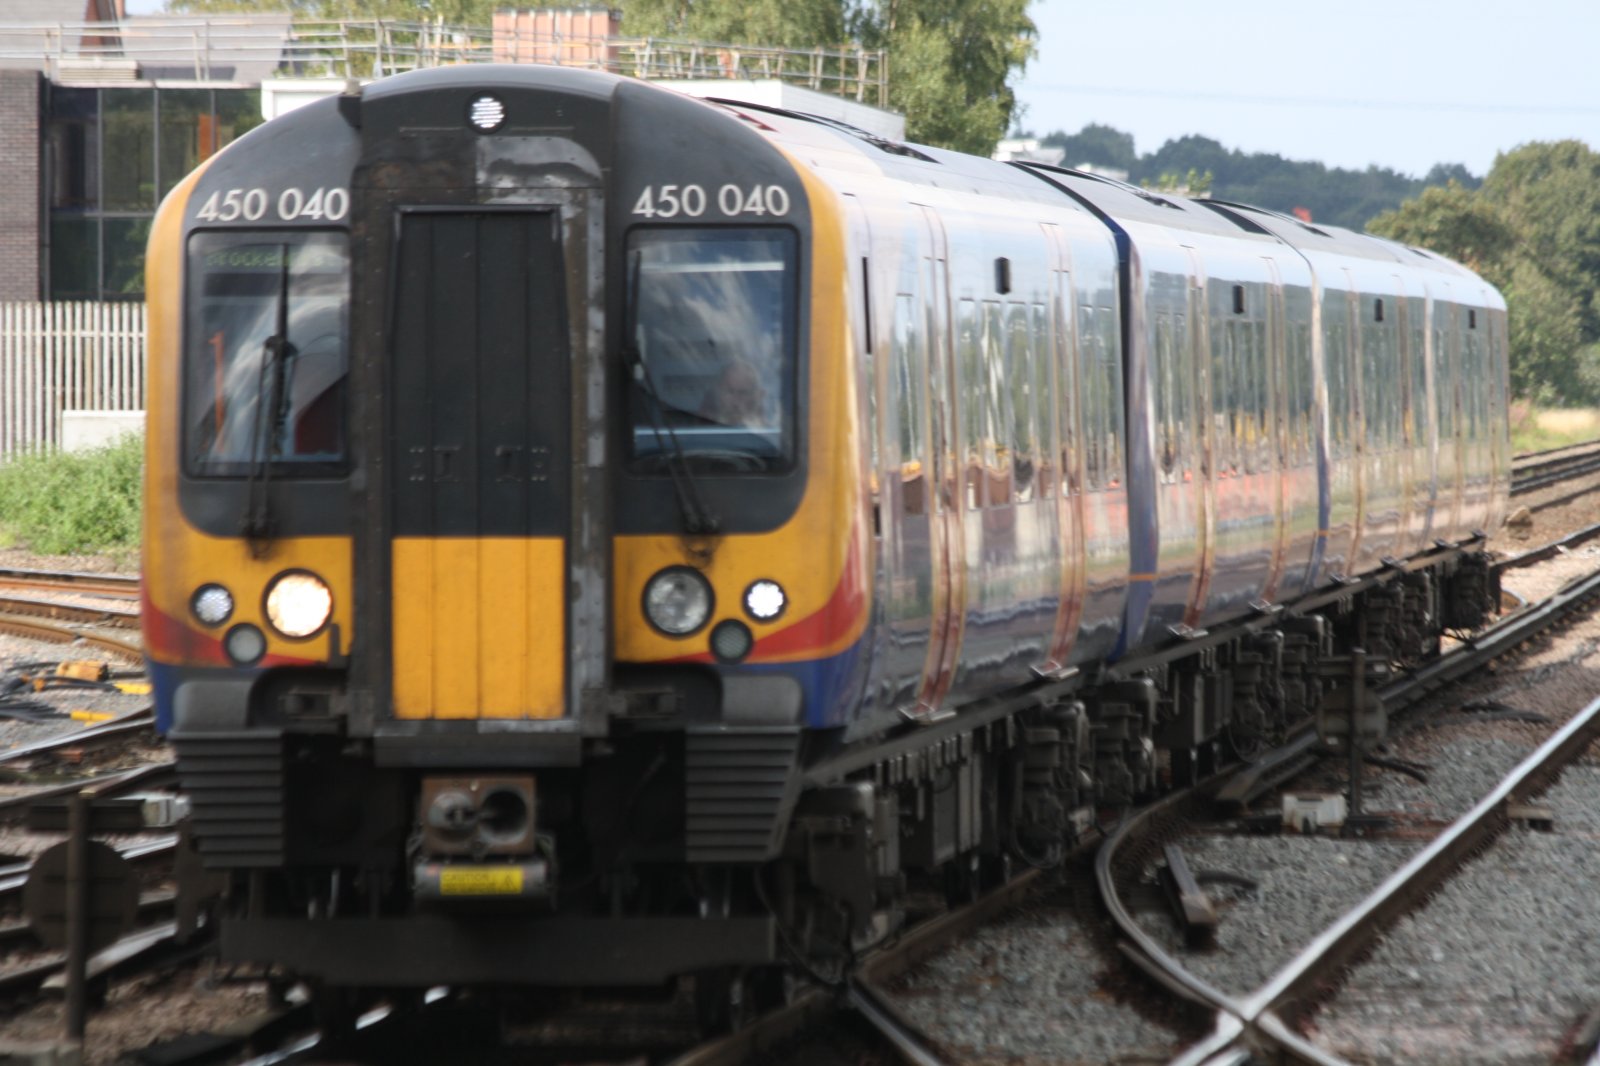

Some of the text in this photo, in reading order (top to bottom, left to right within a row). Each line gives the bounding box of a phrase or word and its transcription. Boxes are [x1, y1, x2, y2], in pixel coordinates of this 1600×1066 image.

[196, 187, 349, 221] 450 040
[631, 184, 790, 218] 450 040
